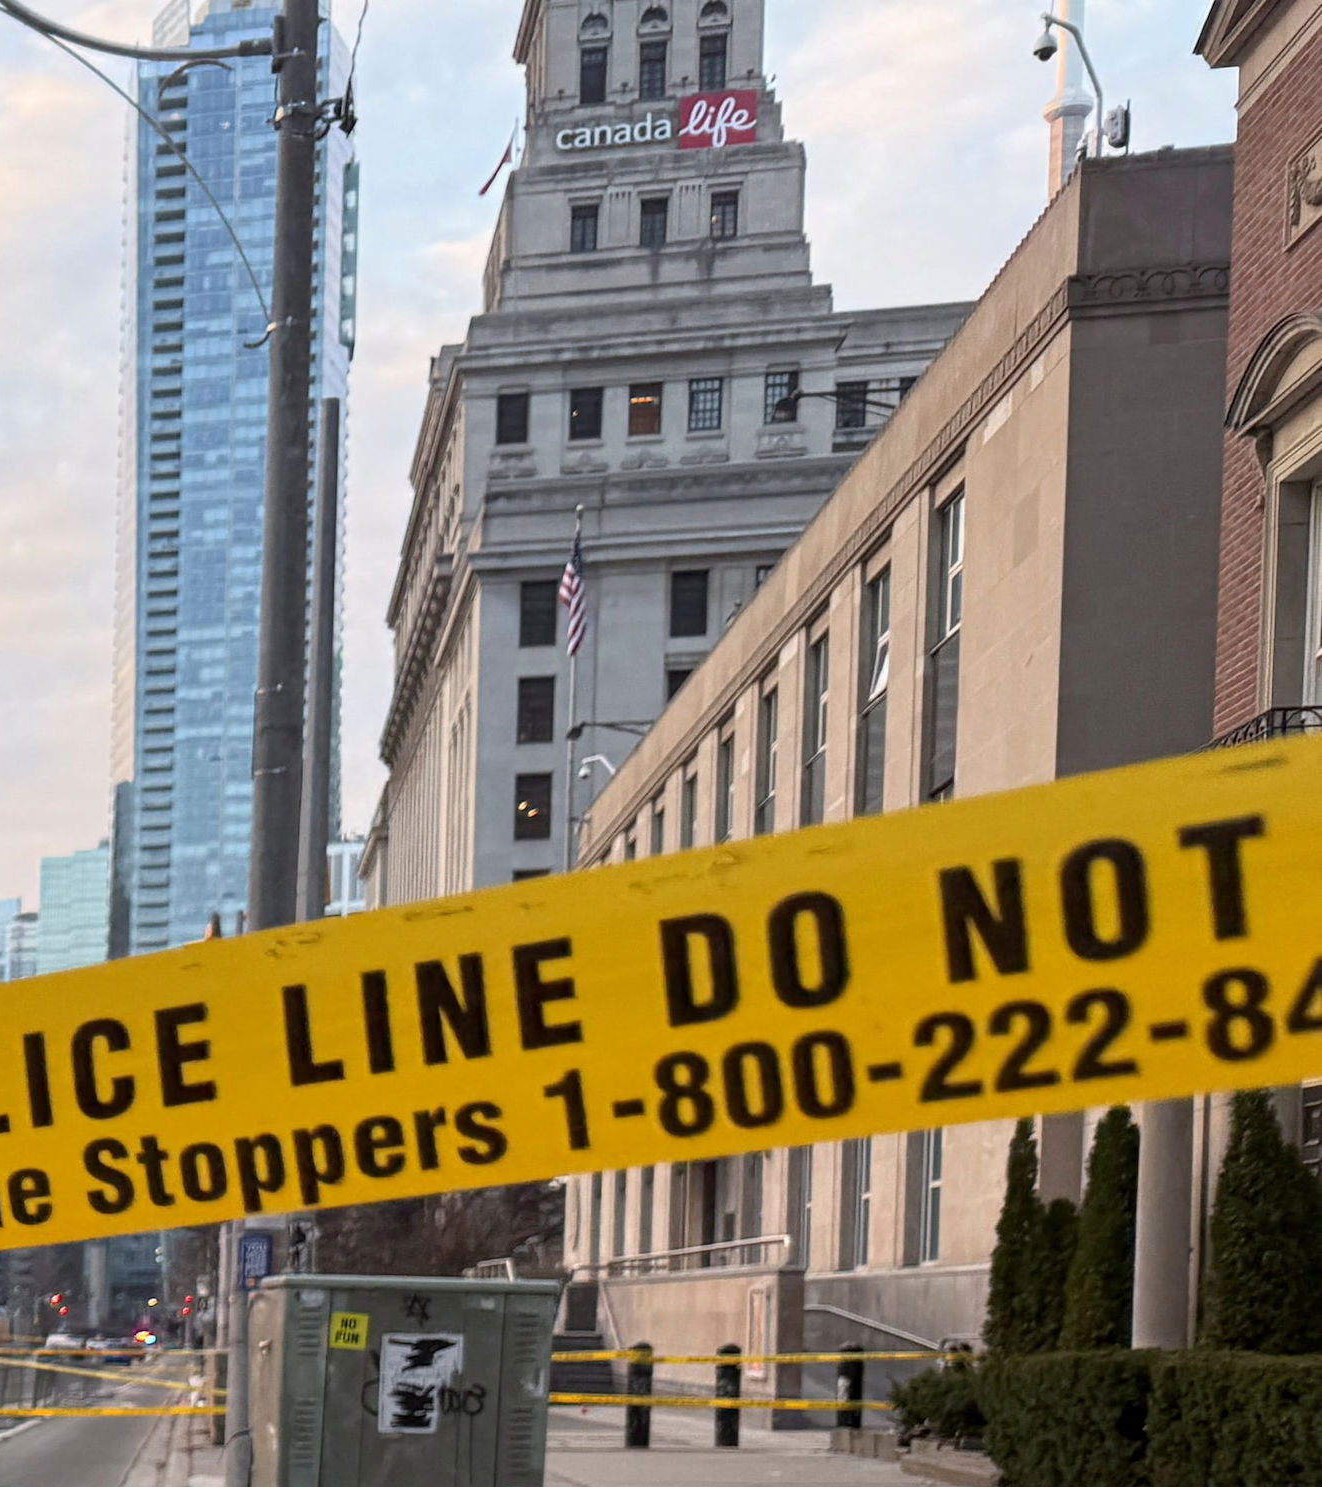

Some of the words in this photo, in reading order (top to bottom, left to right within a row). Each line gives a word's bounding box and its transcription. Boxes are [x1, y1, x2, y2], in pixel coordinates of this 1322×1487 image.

[556, 112, 672, 149] canada
[677, 97, 757, 147] life
[281, 936, 584, 1087] LINE
[658, 890, 851, 1028] DO
[937, 813, 1266, 984] NOT
[82, 1098, 509, 1213] Stoppers
[341, 1318, 357, 1329] NO
